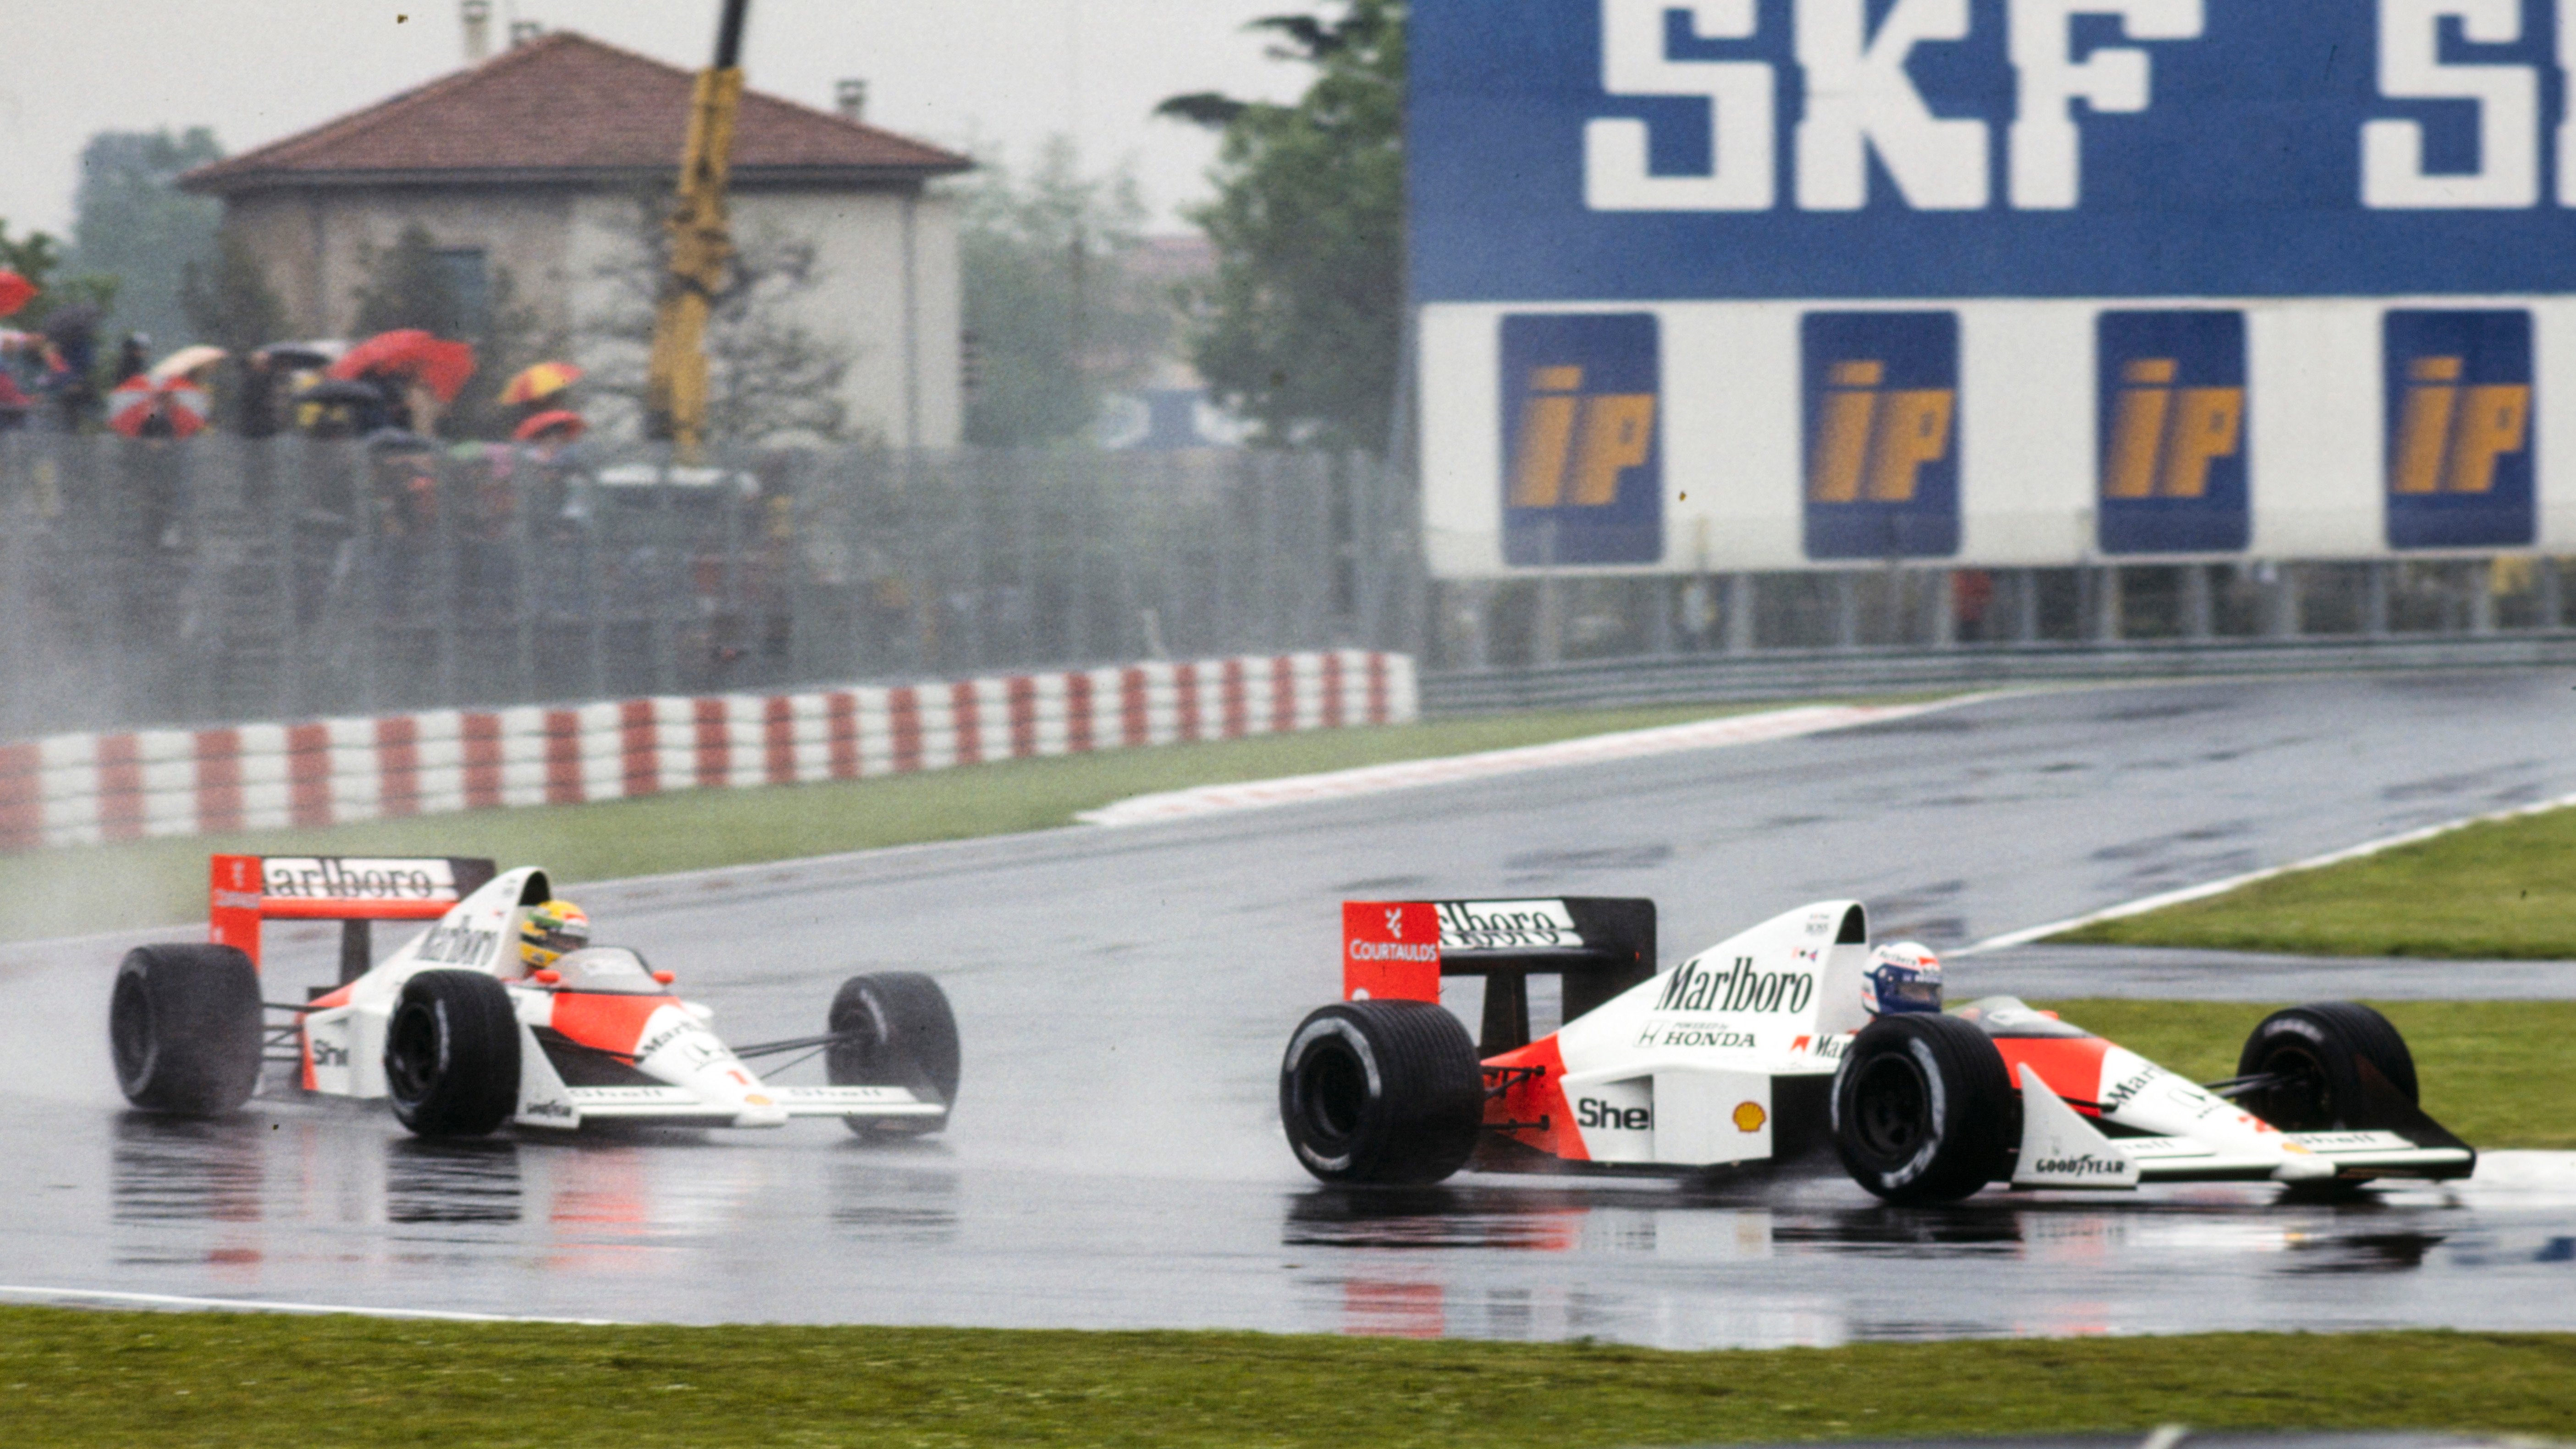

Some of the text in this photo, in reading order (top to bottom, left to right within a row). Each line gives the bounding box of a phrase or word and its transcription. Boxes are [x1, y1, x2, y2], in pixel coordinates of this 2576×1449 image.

[1584, 0, 2205, 210] SKF
[2361, 0, 2576, 210] S
[262, 856, 433, 898] arlboro
[1349, 938, 1437, 961] COURTAULDS
[1654, 956, 1813, 1014] Marlboro
[1664, 1031, 1756, 1047] HONDA
[1578, 1096, 1655, 1131] Shel
[2035, 1153, 2125, 1177] GOODYEAR
